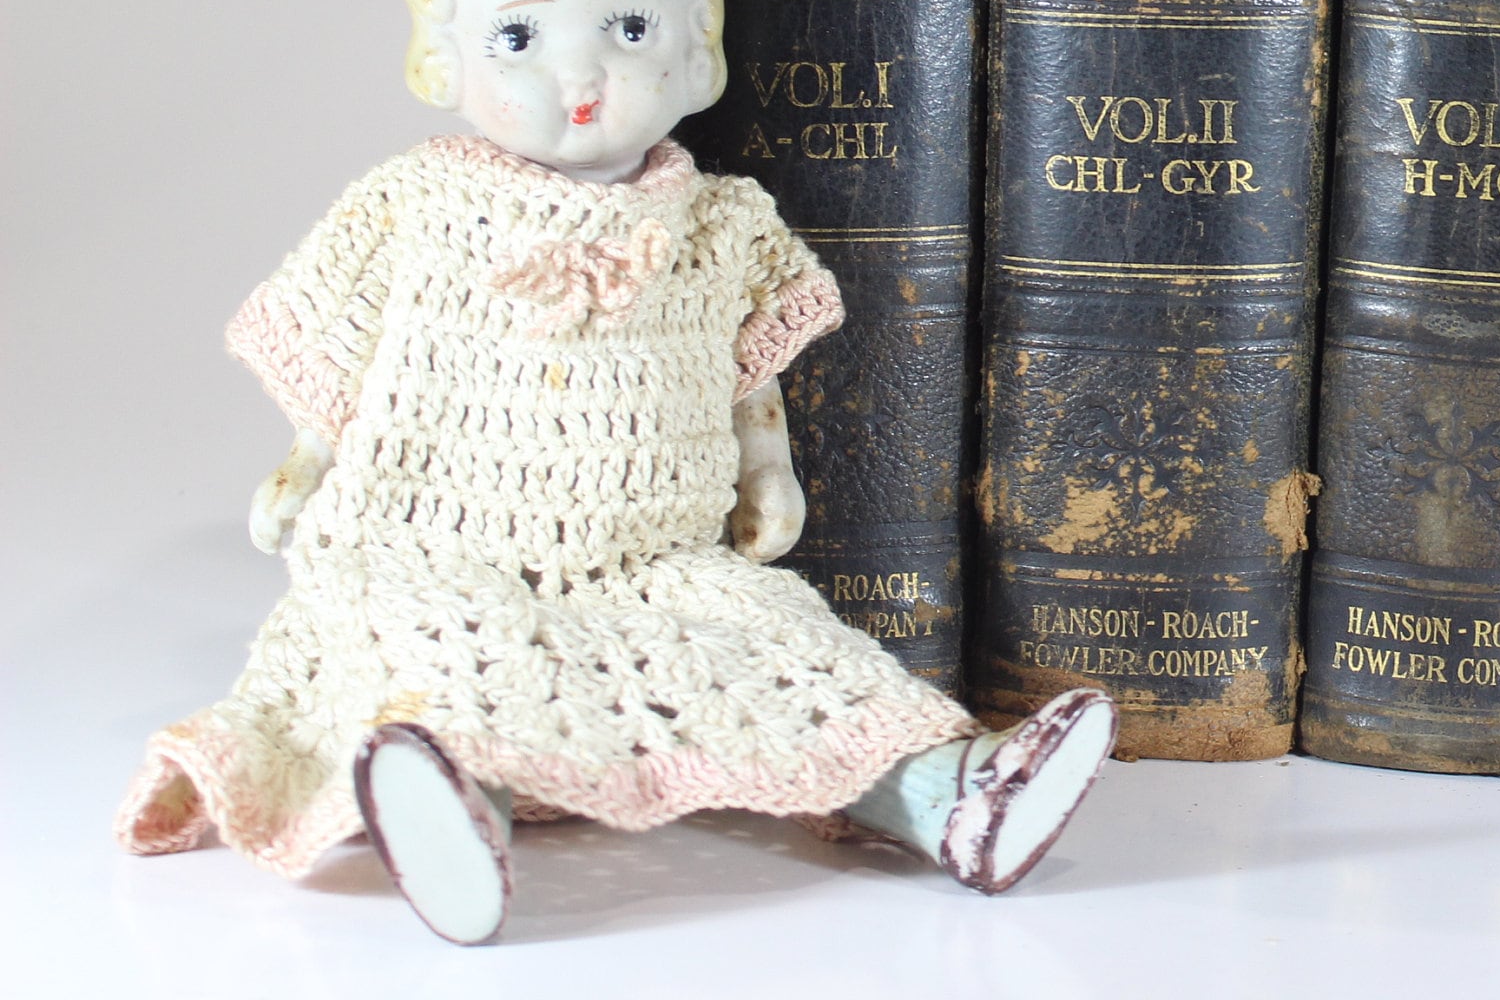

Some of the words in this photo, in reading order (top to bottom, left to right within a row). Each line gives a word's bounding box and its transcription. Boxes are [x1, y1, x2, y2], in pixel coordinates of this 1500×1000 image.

[742, 122, 898, 160] A-CHL
[1020, 640, 1141, 676] FOWLER
[1149, 646, 1269, 678] COMPANY
[1332, 642, 1447, 683] FOWLER
